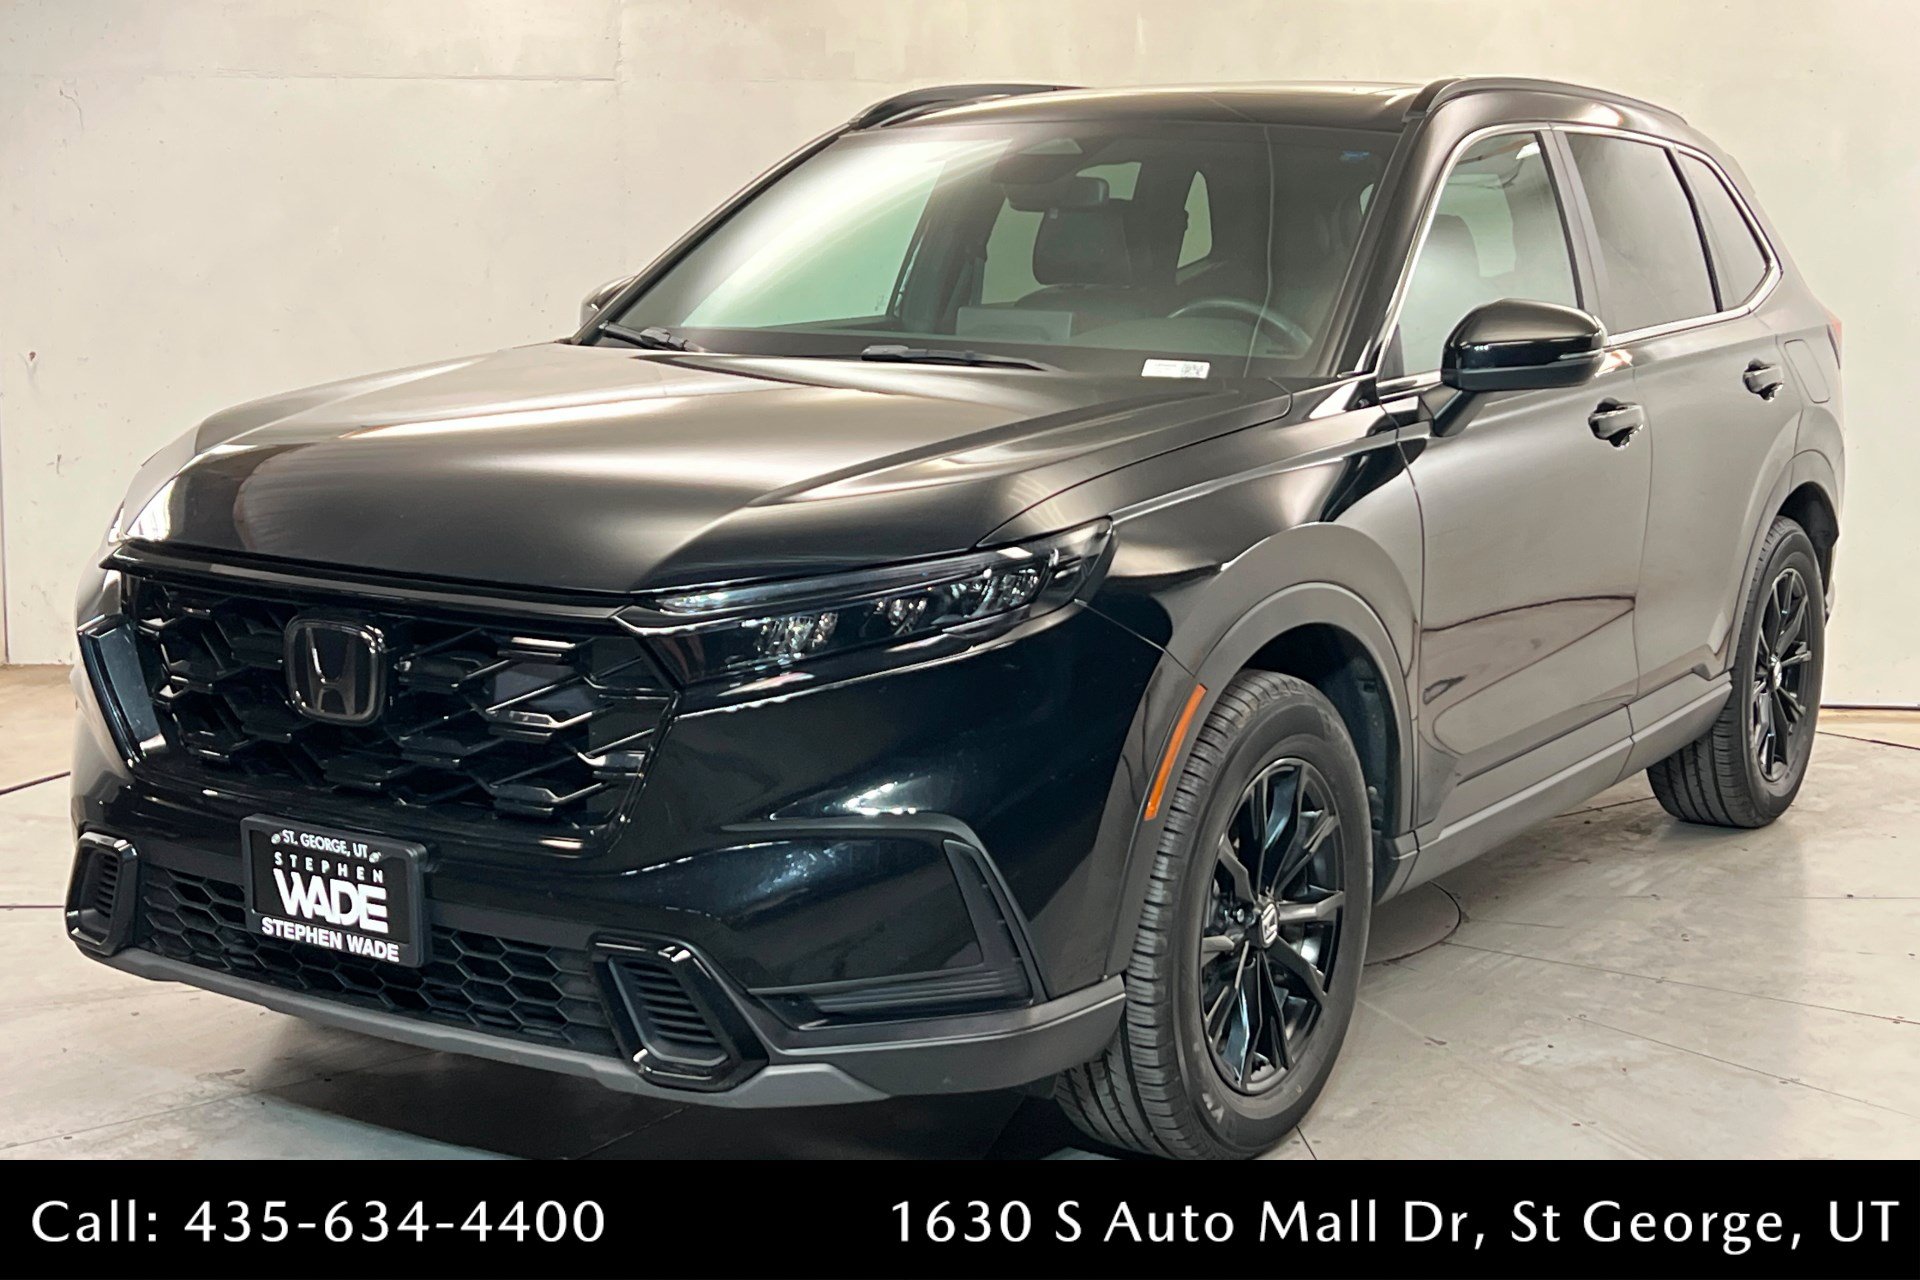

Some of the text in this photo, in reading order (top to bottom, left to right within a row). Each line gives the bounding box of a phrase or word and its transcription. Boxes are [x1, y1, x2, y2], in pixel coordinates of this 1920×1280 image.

[282, 829, 368, 859] ST. GEORGE, UT
[274, 851, 384, 884] STEPHEN
[272, 867, 388, 934] WADE
[261, 916, 400, 963] STEPHEN WADE
